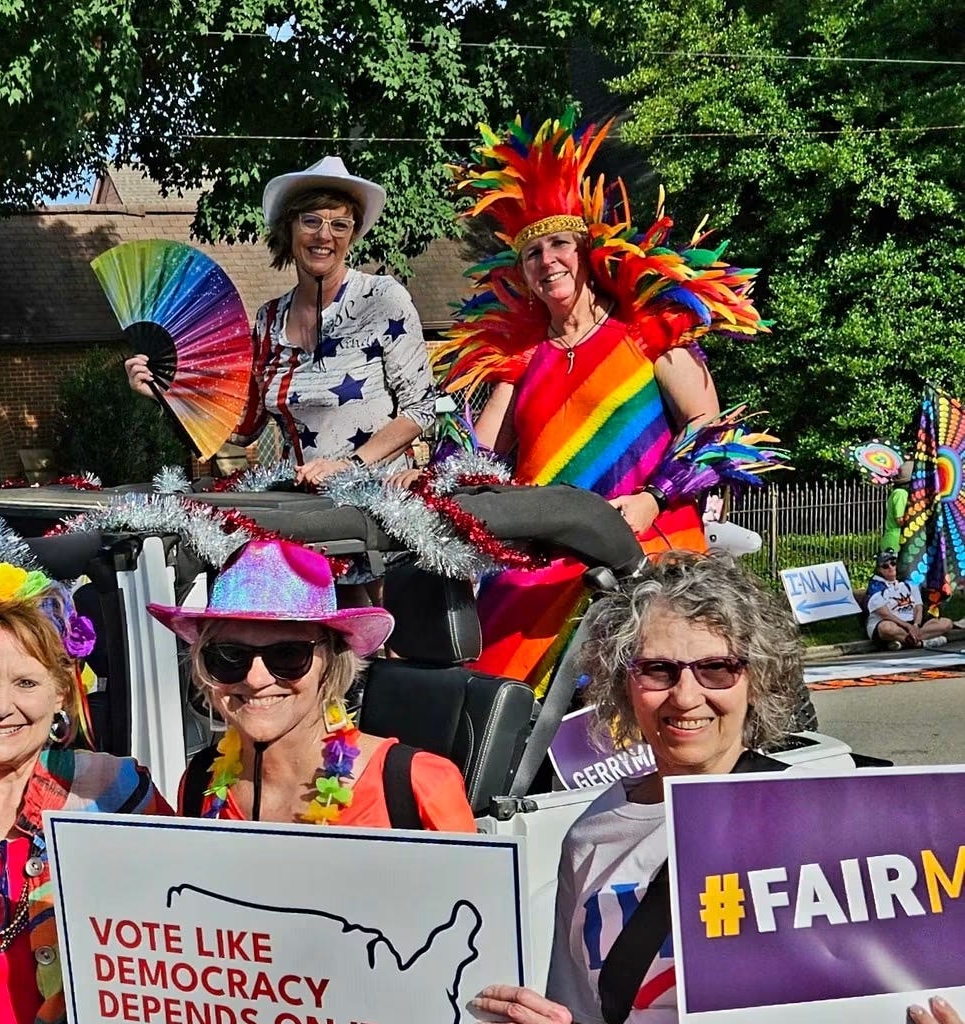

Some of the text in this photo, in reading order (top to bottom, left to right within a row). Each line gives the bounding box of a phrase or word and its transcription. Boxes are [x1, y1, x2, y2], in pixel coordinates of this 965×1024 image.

[90, 917, 272, 963] VOTE LIKE
[95, 953, 330, 1008] DEMOCRACY
